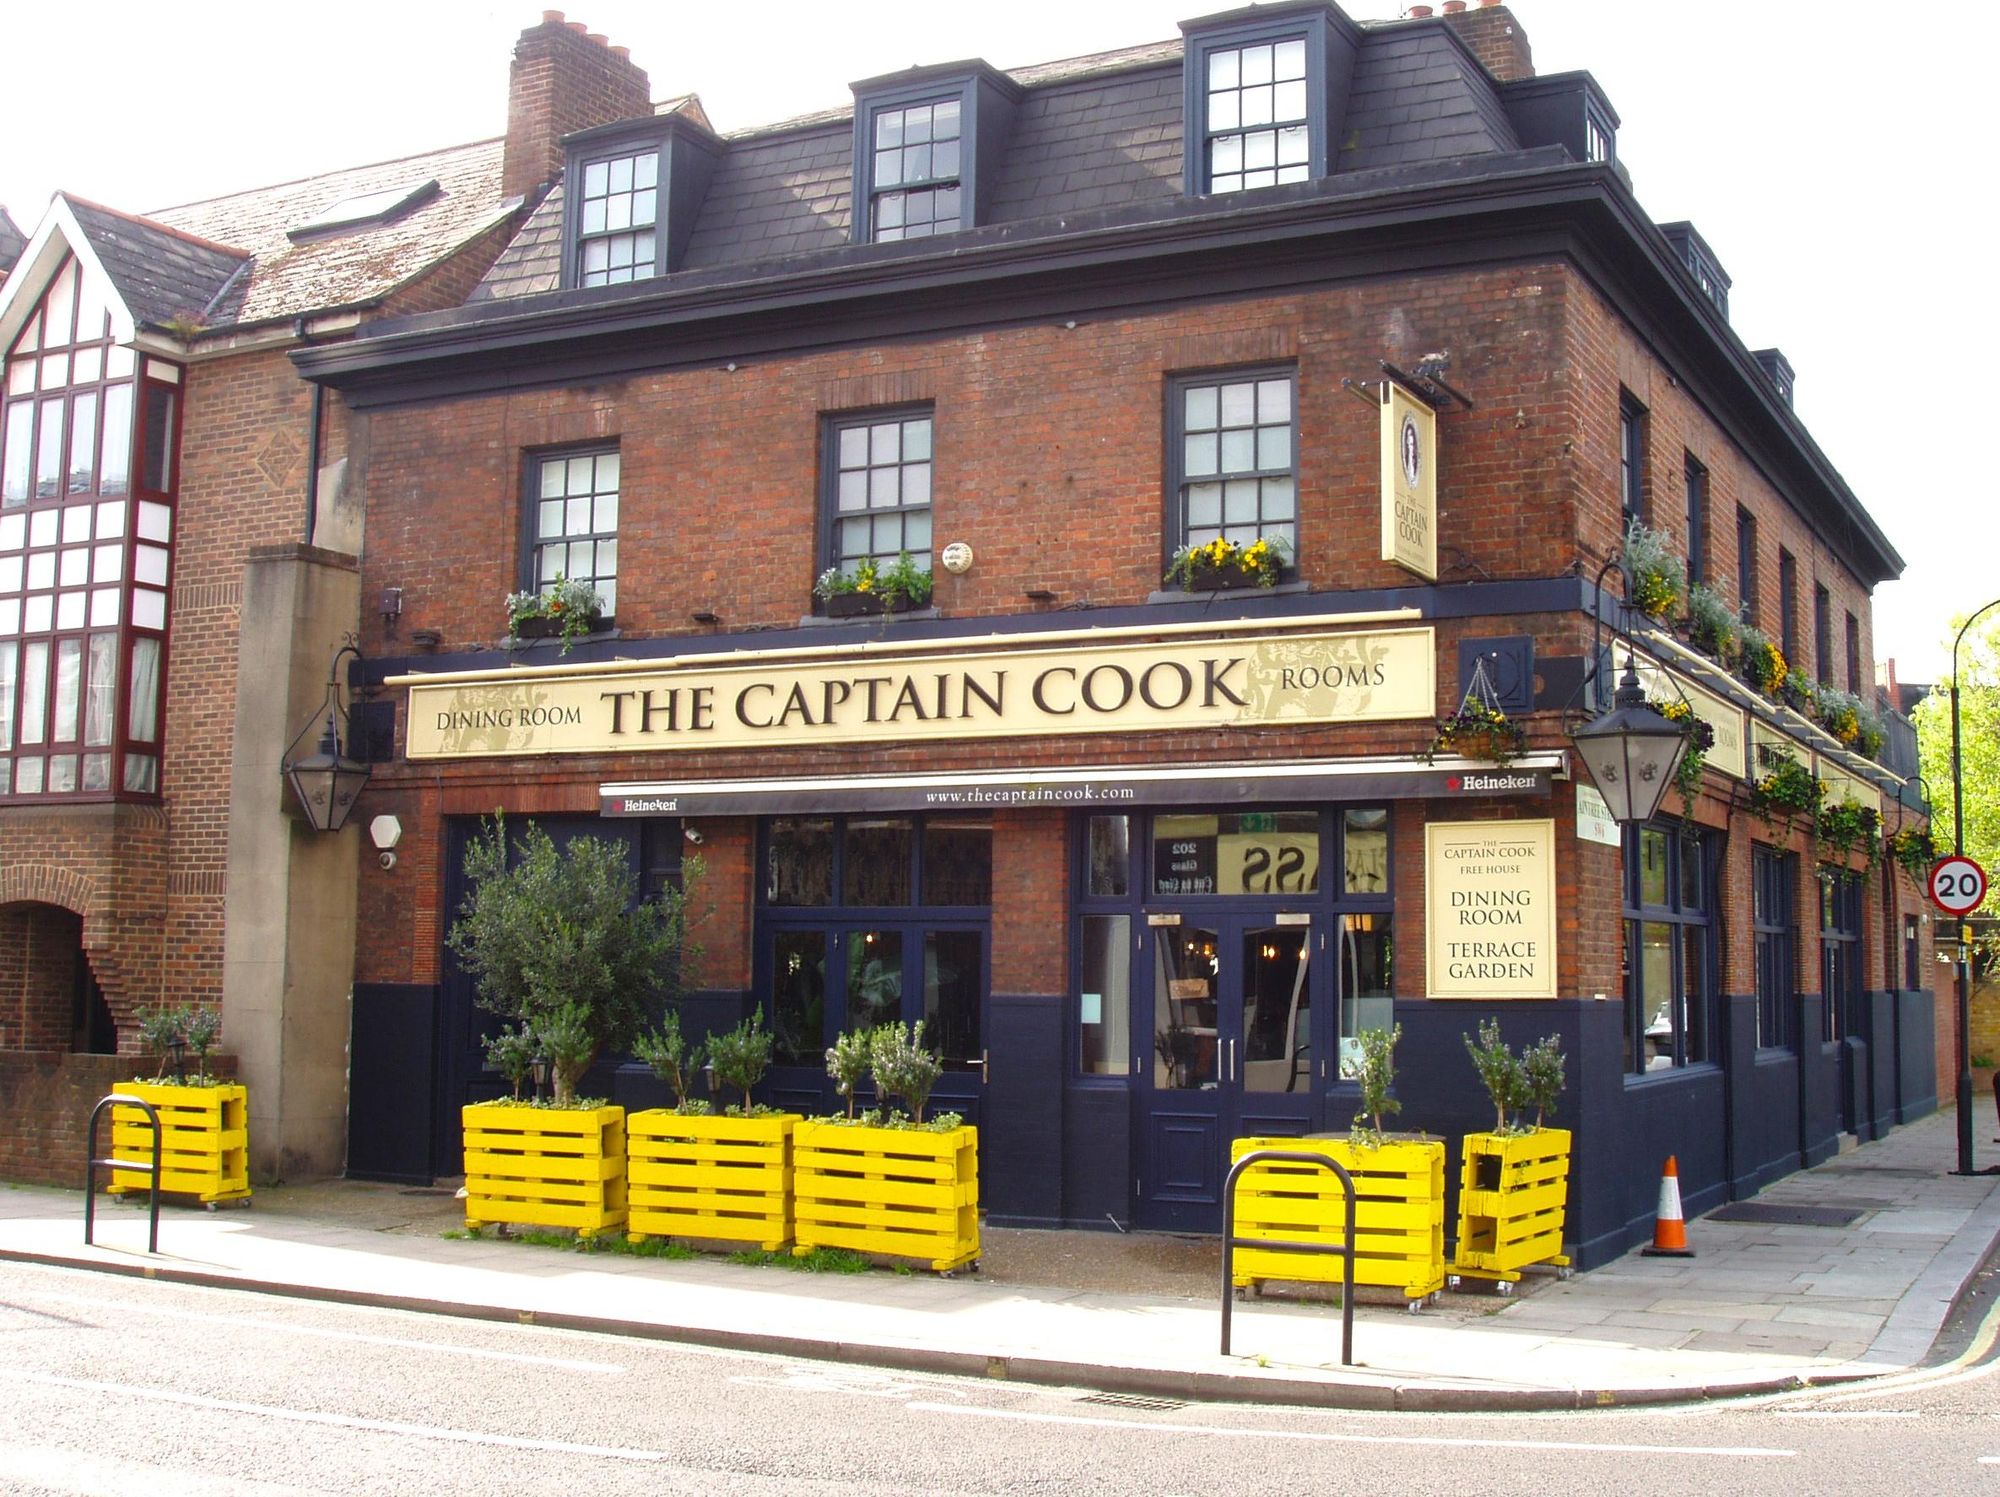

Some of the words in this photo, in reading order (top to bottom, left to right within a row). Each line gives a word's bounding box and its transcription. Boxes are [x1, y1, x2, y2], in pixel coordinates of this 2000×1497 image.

[1395, 500, 1428, 532] CAPTAIN
[1399, 521, 1423, 548] COOK
[1281, 663, 1386, 690] ROOMS
[600, 686, 714, 734] THE
[735, 670, 1007, 729] CAPTAIN
[1032, 657, 1250, 714] COOK
[436, 708, 513, 731] DINING
[519, 706, 582, 728] ROOM
[1463, 774, 1537, 790] Heineken
[926, 785, 1134, 804] www.thecaptaincook.com
[623, 799, 678, 813] Heineken
[1483, 840, 1497, 848] THE
[1444, 848, 1495, 859] CAPTAIN
[1499, 847, 1535, 858] COOK
[1460, 866, 1483, 874] FREE
[1486, 865, 1521, 874] HOUSE
[1938, 873, 1978, 897] 20
[1451, 890, 1531, 907] DINING
[1459, 909, 1522, 925] ROOM
[1447, 942, 1536, 958] TERRACE
[1449, 963, 1534, 979] GARDEN
